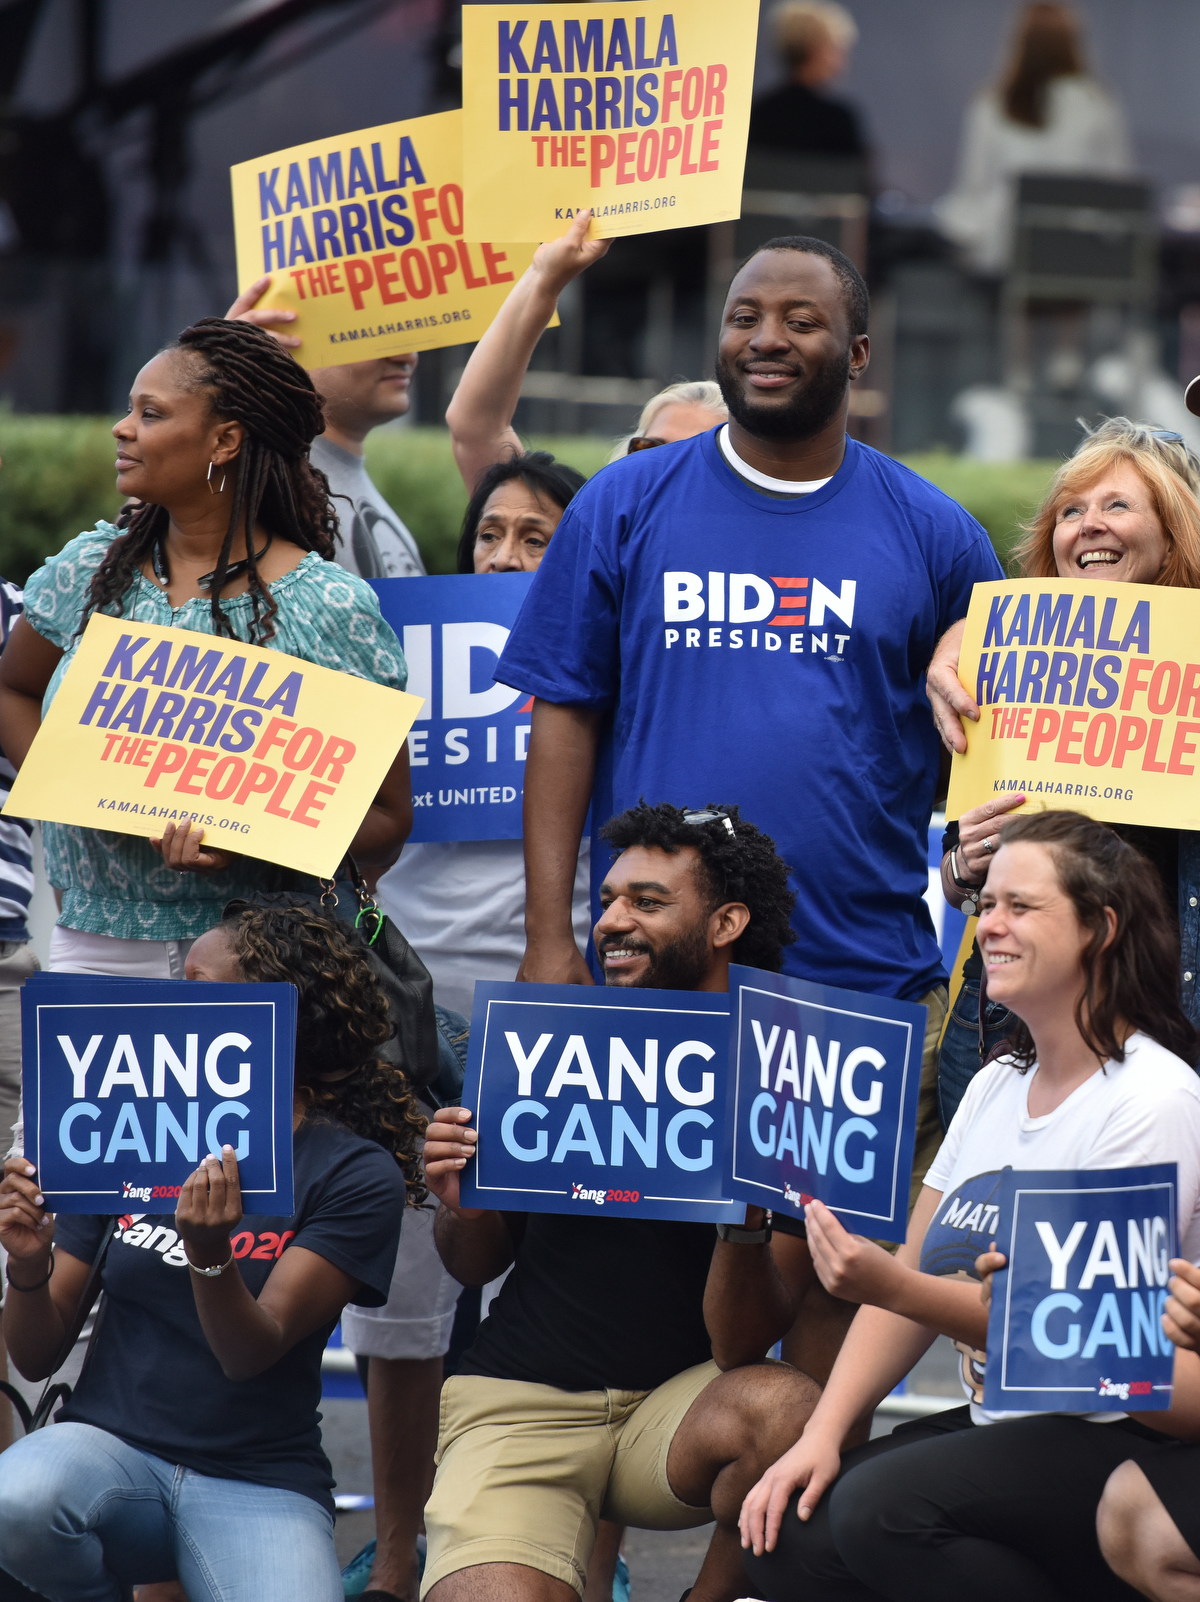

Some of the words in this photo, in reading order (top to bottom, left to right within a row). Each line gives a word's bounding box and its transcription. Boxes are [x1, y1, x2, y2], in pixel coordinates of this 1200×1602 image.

[499, 14, 678, 74] KAMALA
[498, 72, 659, 132] HARRIS
[661, 64, 729, 124] FOR
[258, 135, 426, 220] KAMALA
[532, 135, 586, 168] THE
[590, 119, 723, 188] PEOPLE
[261, 193, 415, 273] HARRIS
[412, 183, 463, 241] FO
[289, 262, 345, 300] THE
[343, 241, 514, 311] PEOPLE
[329, 309, 472, 344] KAMALAHARRIS.ORG
[663, 571, 857, 629] BIDEN
[982, 593, 1151, 655] KAMALA
[102, 633, 303, 717] KAMALA
[665, 628, 851, 655] PRESIDENT
[976, 650, 1122, 709] HARRIS
[79, 681, 263, 754] HARRIS
[253, 716, 357, 784] FOR
[990, 707, 1030, 740] THE
[100, 733, 159, 769] THE
[143, 742, 337, 828] PEOPLE
[438, 786, 517, 806] UNITED
[993, 780, 1134, 802] KAMALAHARRIS.ORG
[97, 798, 251, 835] KAMALAHARRIS.ORG
[56, 1032, 252, 1098] YANG
[504, 1031, 717, 1107] YANG
[751, 1019, 887, 1117] YANG
[58, 1100, 251, 1164] GANG
[501, 1099, 714, 1173] GANG
[749, 1092, 878, 1184] GANG
[571, 1182, 640, 1205] Yang2020
[1034, 1215, 1167, 1290] YANG
[1031, 1289, 1173, 1360] GANG
